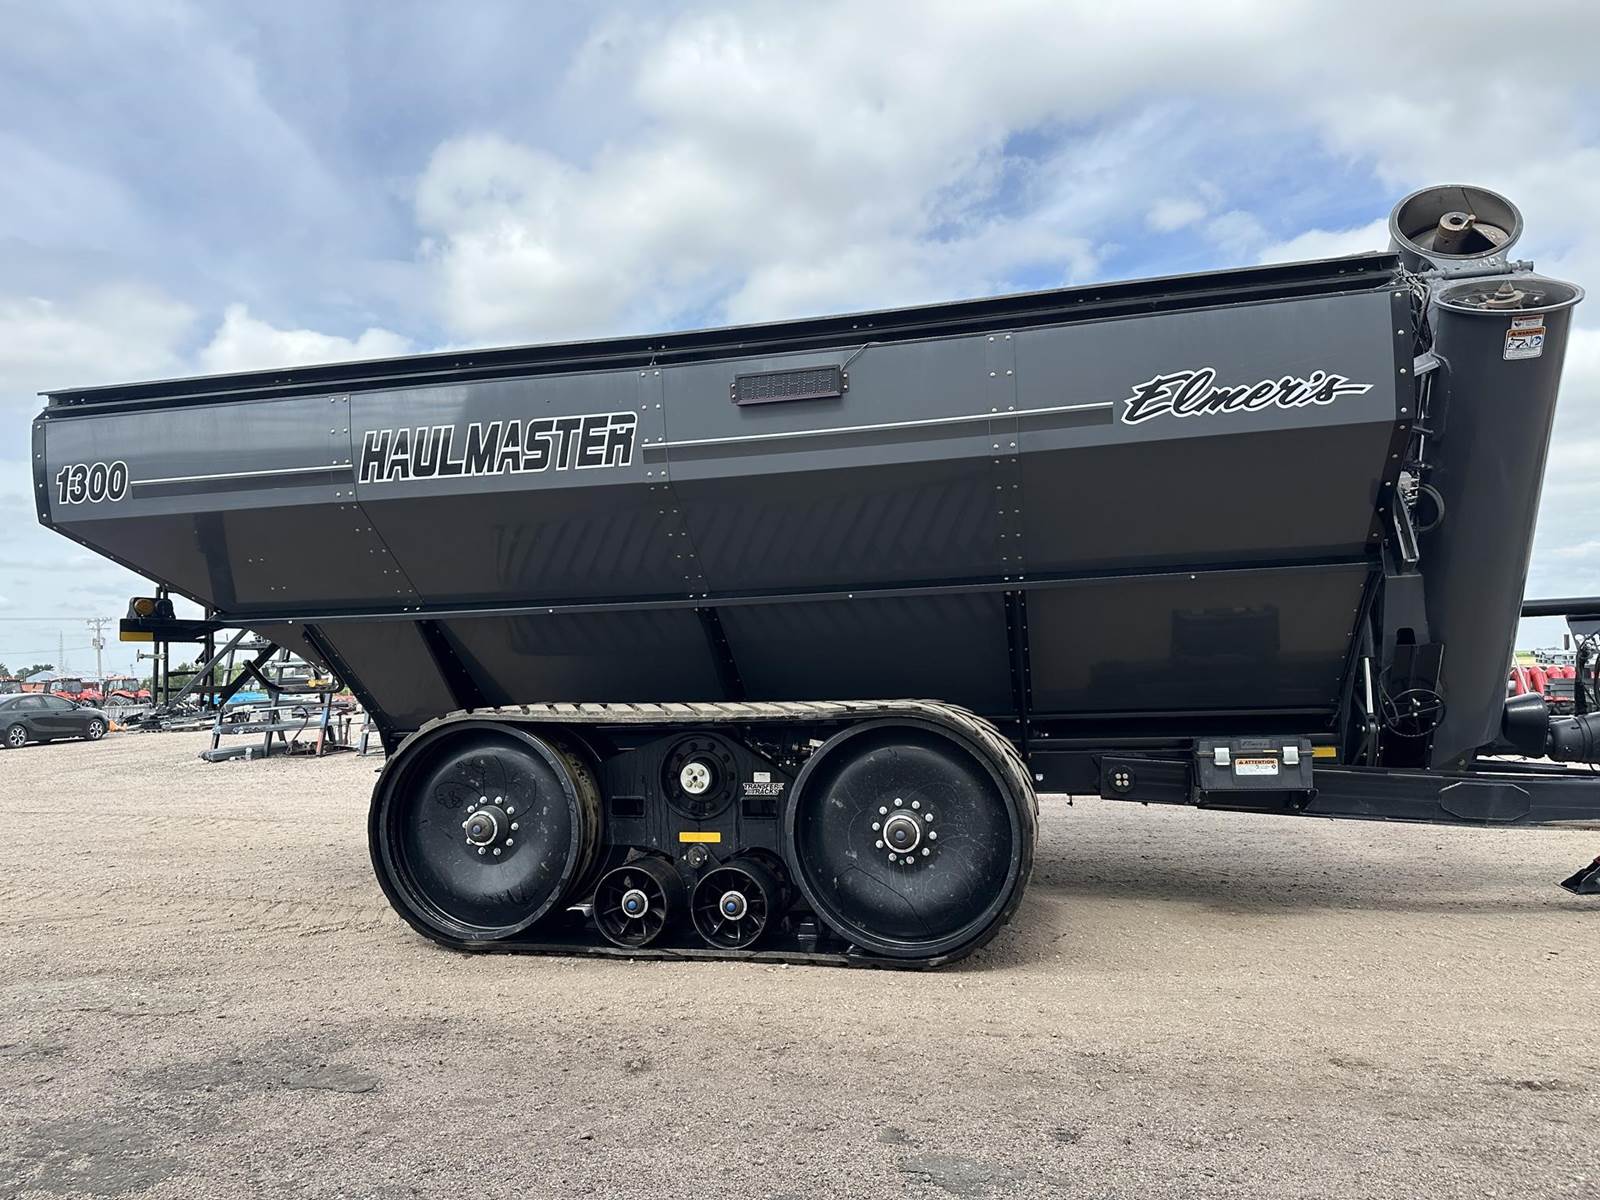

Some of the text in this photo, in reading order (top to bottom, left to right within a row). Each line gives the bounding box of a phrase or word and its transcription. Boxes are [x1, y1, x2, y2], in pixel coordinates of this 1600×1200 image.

[1121, 367, 1374, 424] Elmer's
[358, 411, 637, 484] HAULMASTER
[56, 461, 128, 504] 1300
